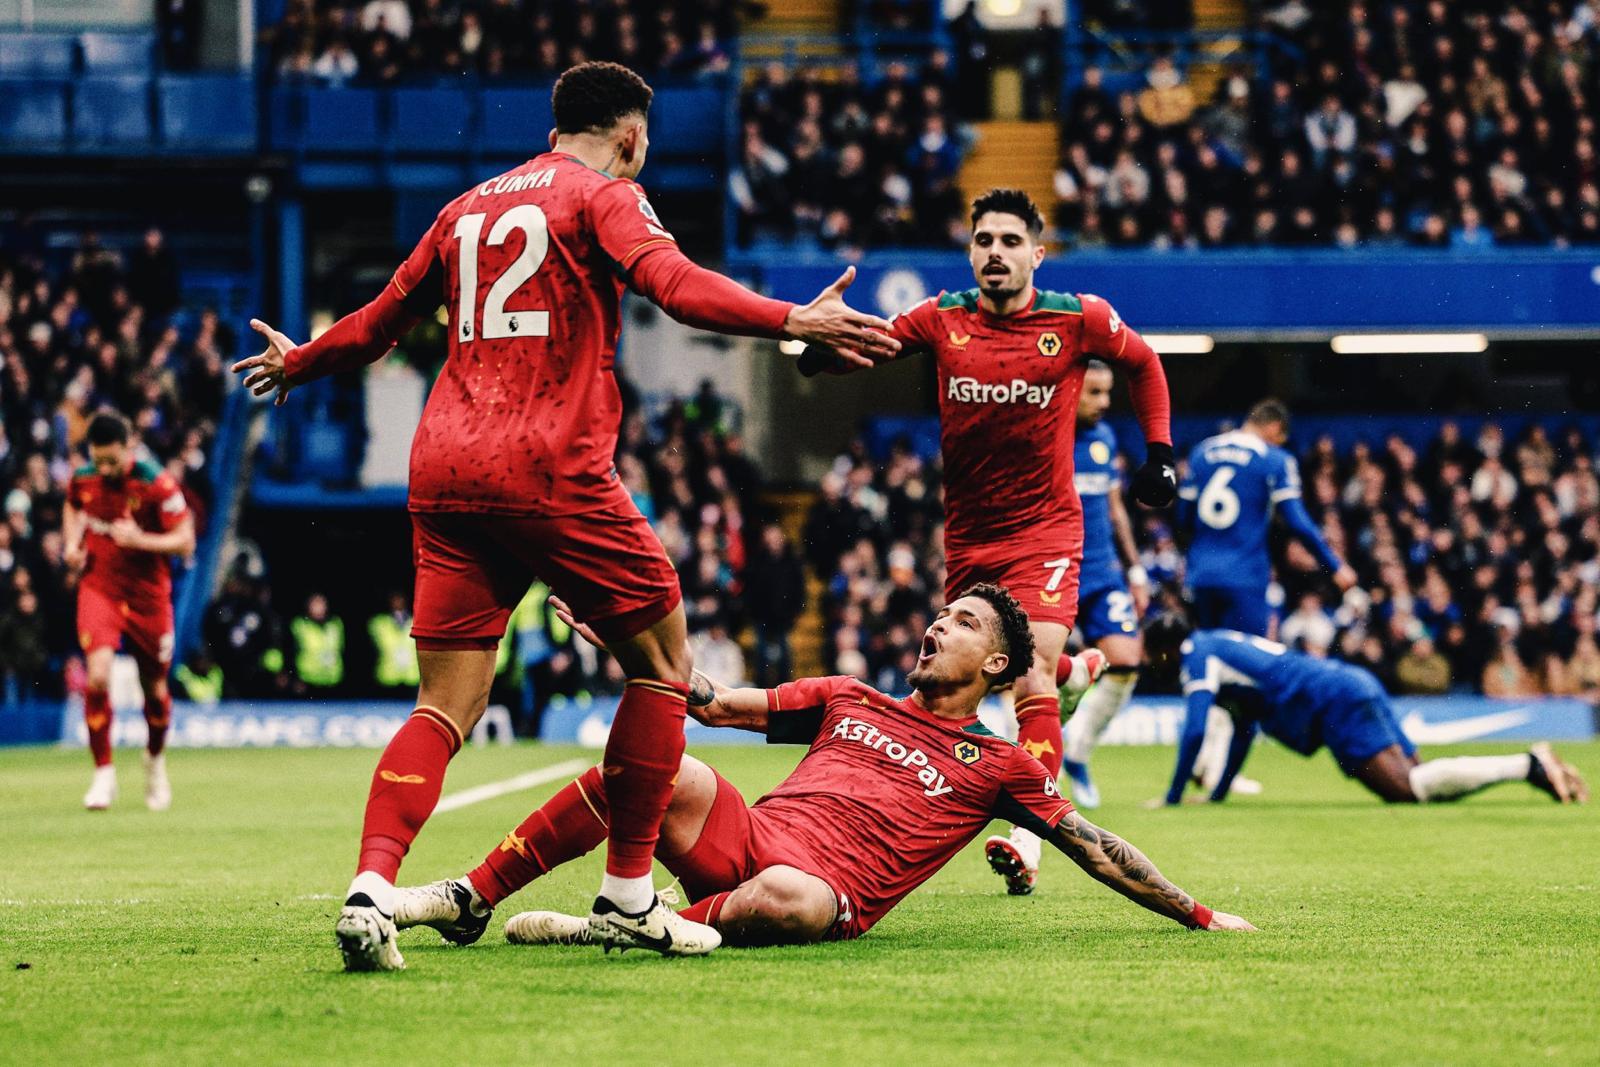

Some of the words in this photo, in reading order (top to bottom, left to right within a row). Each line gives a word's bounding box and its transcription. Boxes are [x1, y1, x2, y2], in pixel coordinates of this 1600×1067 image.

[479, 168, 557, 197] CUNHA
[453, 204, 550, 343] 12
[948, 376, 1056, 410] AstroPay
[1198, 465, 1240, 530] 6
[1043, 557, 1070, 591] 7
[829, 717, 954, 797] AstroPay
